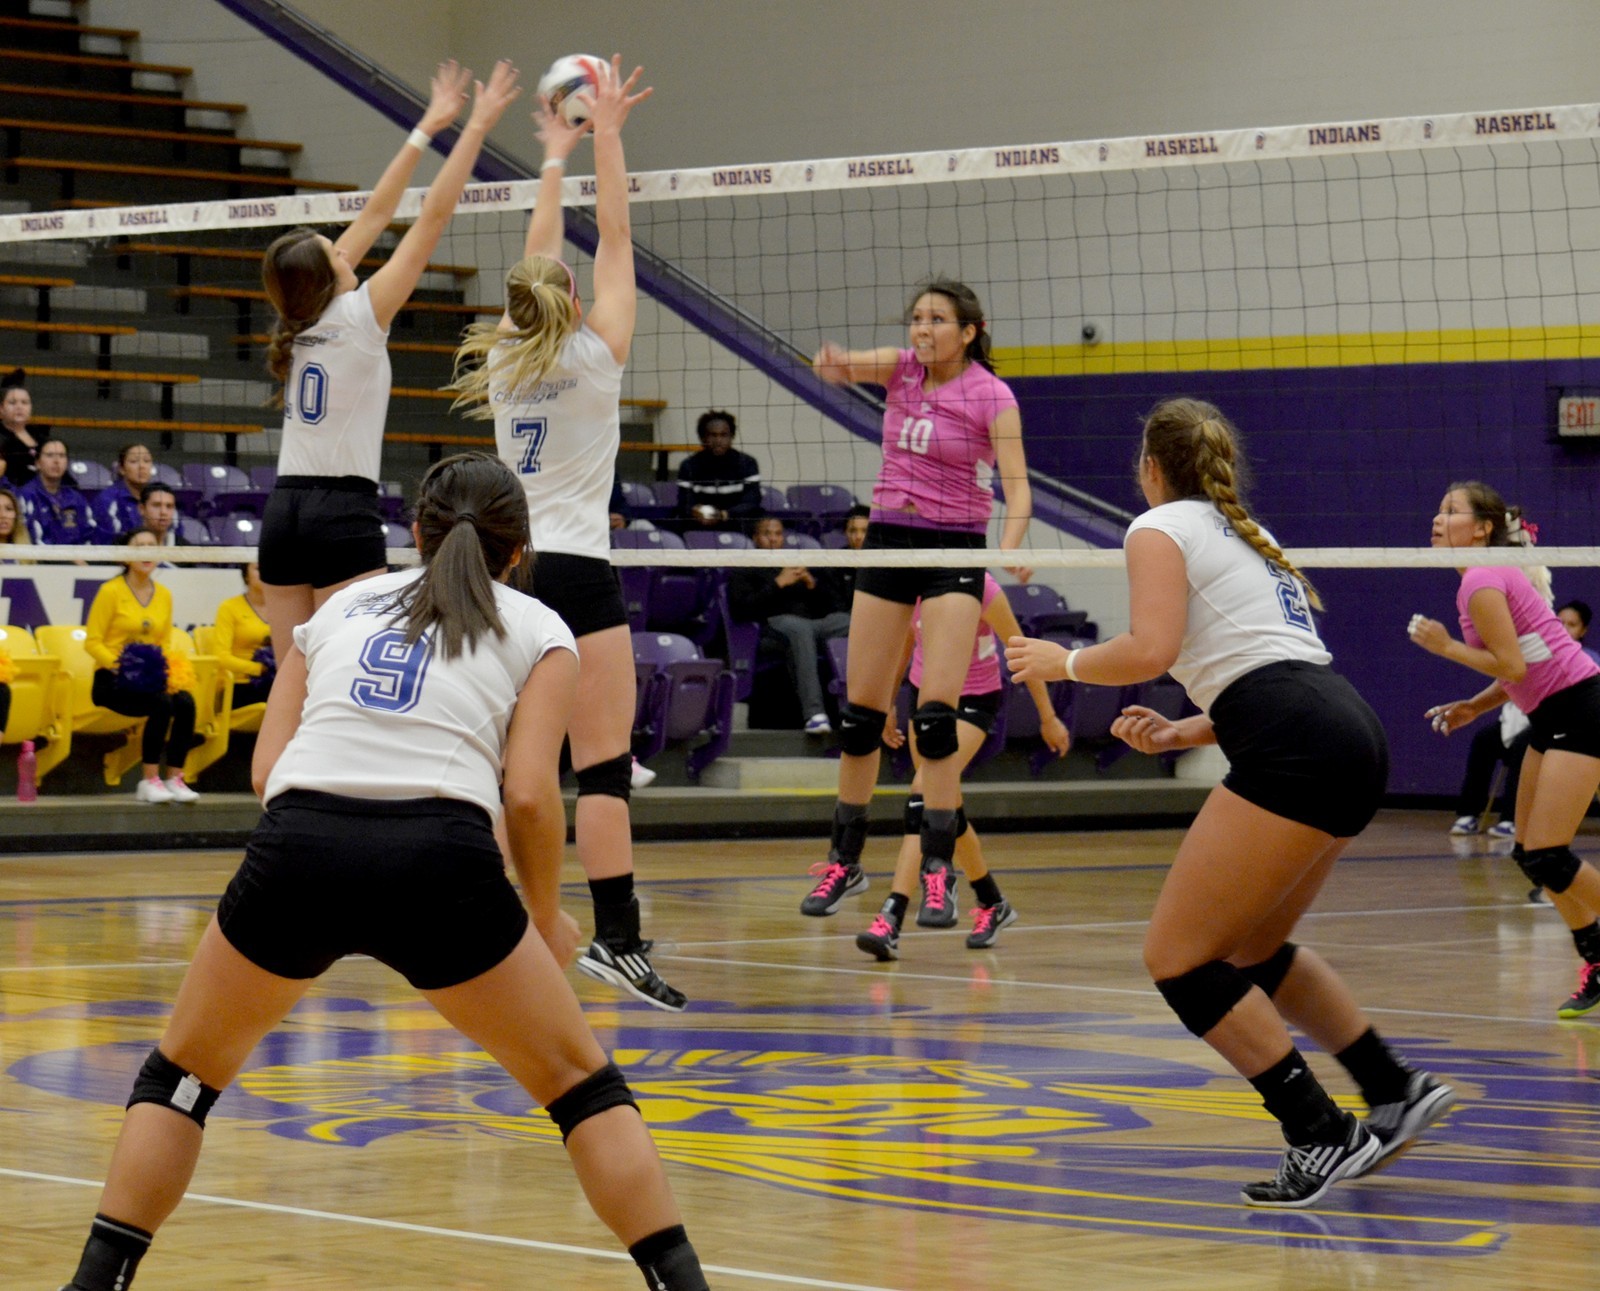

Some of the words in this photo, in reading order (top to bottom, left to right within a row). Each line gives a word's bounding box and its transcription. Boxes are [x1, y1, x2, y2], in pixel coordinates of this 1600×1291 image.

[21, 216, 65, 232] INDIANS
[118, 209, 169, 226] HASKELL
[228, 202, 277, 220] INDIANS
[712, 168, 773, 187] INDIANS
[847, 158, 914, 178] HASKELL
[995, 147, 1060, 167] INDIANS
[1145, 137, 1219, 158] HASKELL
[1308, 124, 1381, 146] INDIANS
[1474, 112, 1556, 135] HASKELL
[511, 417, 547, 475] 7
[897, 416, 934, 455] 10
[1265, 558, 1313, 633] 2
[350, 627, 434, 713] 9
